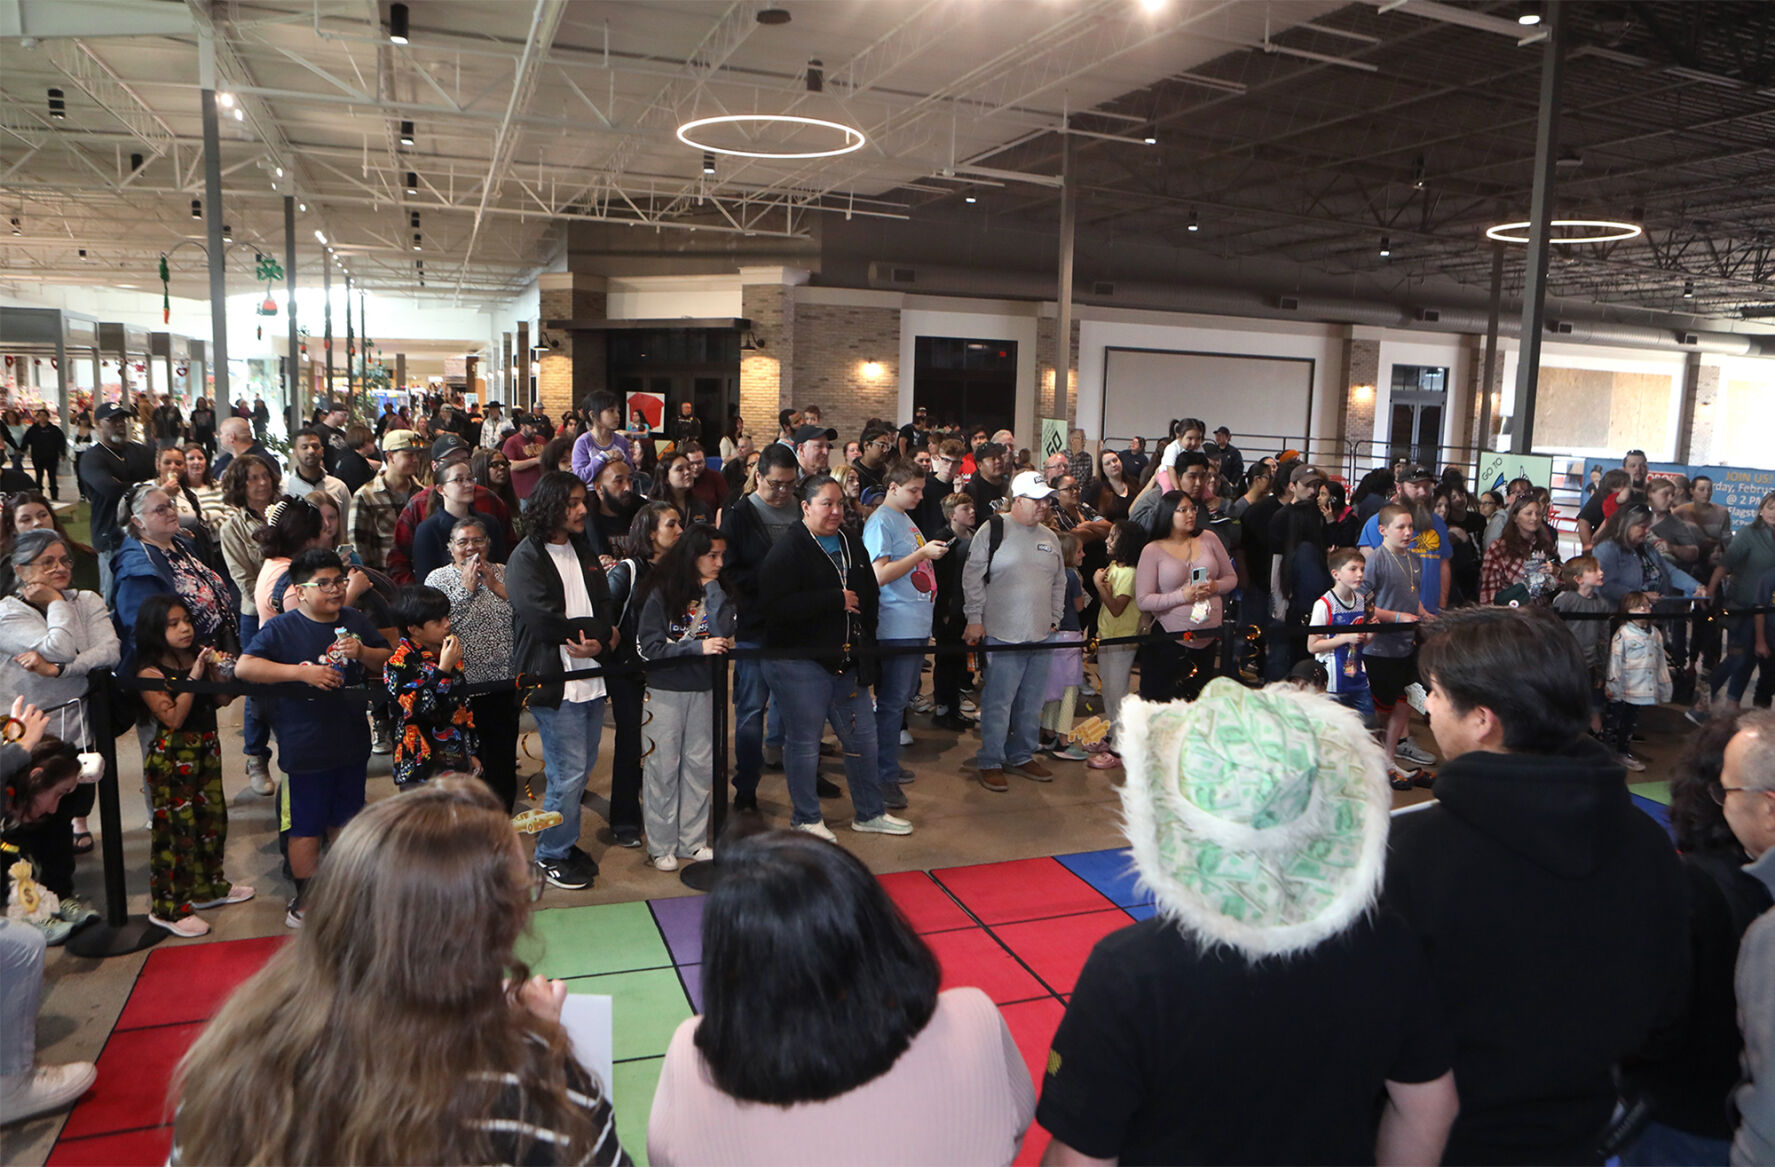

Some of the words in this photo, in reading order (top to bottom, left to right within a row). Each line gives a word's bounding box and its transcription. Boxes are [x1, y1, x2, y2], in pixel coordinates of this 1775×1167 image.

[1046, 430, 1063, 457] GO
[1481, 467, 1494, 481] GO
[1492, 457, 1503, 469] TO
[1726, 472, 1751, 482] JOIN
[1754, 472, 1774, 484] US!
[1726, 494, 1737, 505] @
[1740, 495, 1747, 505] 2
